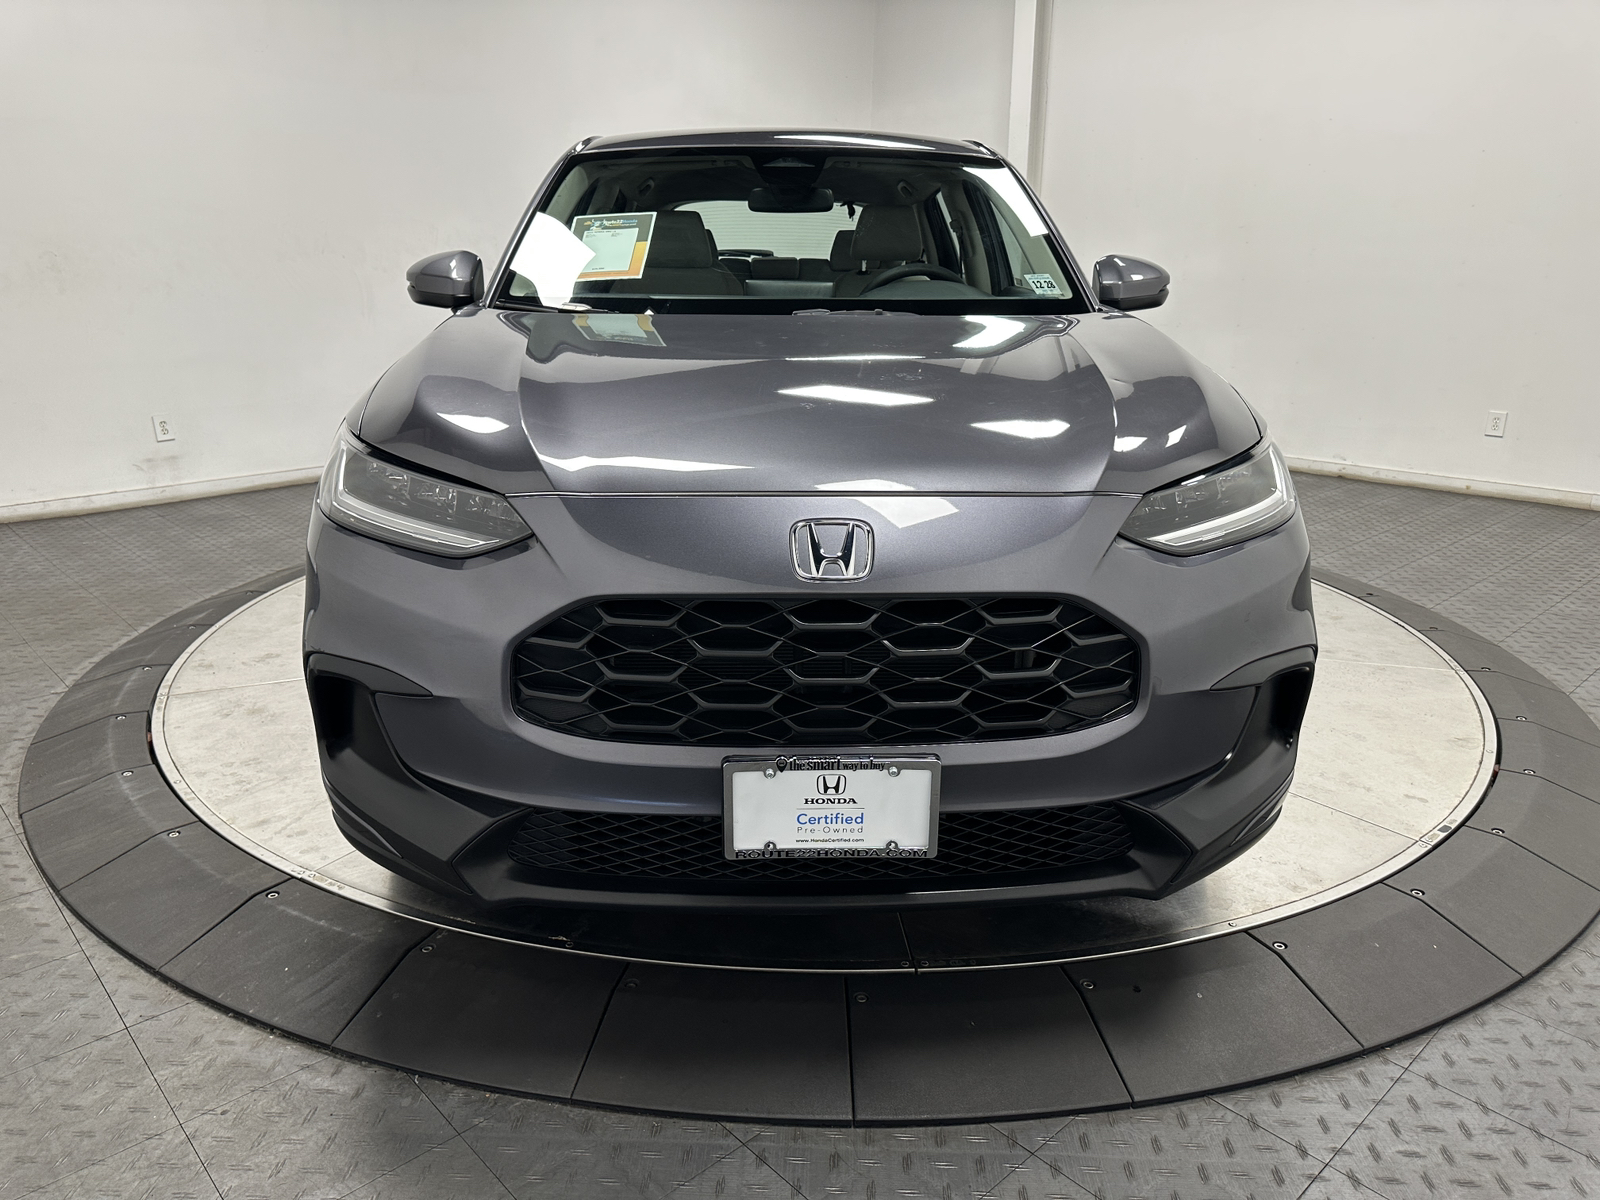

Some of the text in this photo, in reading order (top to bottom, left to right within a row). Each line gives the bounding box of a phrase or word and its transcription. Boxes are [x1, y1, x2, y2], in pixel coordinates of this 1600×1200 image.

[1032, 280, 1045, 289] 12
[789, 757, 886, 772] the smart way to buy
[803, 797, 858, 805] HONDA
[796, 812, 865, 825] Certified
[796, 826, 864, 834] Pre-Owned
[735, 849, 929, 859] ROUTE22HONDA.COM
